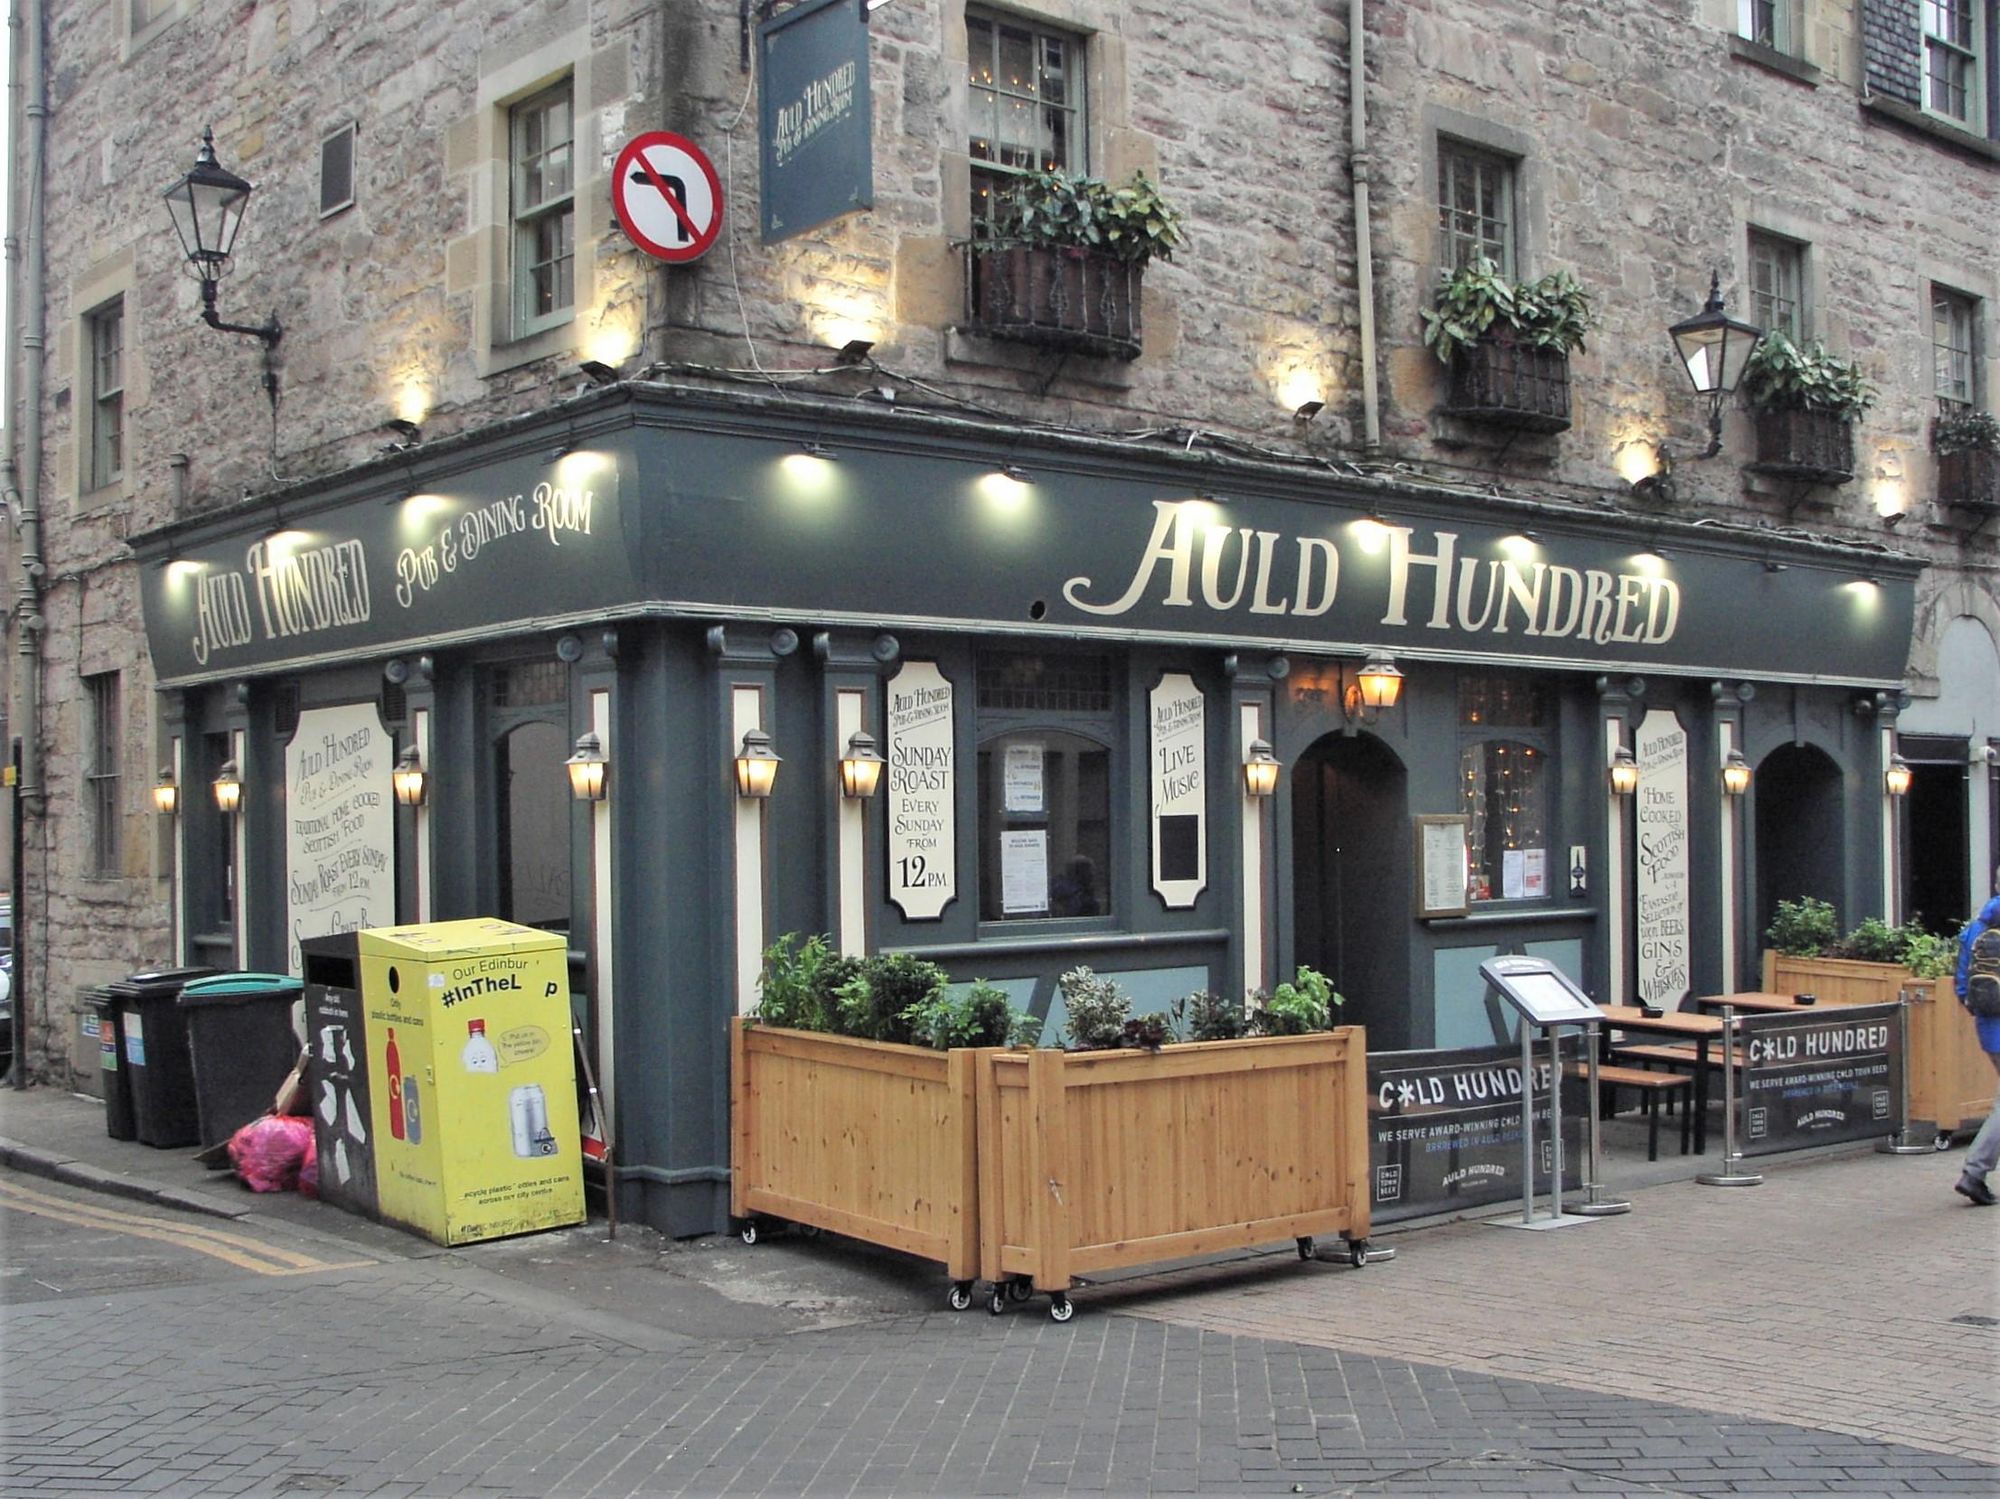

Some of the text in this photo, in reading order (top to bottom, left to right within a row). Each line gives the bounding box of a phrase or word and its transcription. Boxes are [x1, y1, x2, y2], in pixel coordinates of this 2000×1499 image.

[772, 61, 856, 147] AULD HUNDRED
[396, 482, 594, 608] PUB & DINING ROOM
[1062, 499, 1681, 646] AULD HUNDRED
[193, 538, 371, 665] AULD HUNDRED
[889, 687, 951, 717] AULD HUNDRED
[1154, 696, 1203, 729] AULD HUNDRED
[294, 727, 370, 793] AULD HUNDRED
[891, 737, 952, 770] SUNDAY
[1159, 744, 1196, 774] LIVE
[890, 766, 950, 795] ROAST
[1154, 770, 1200, 819] MUSIC
[902, 798, 939, 816] EVERY
[1644, 787, 1675, 805] HOME
[894, 813, 944, 836] SUNDAY
[1640, 806, 1682, 824] COOKED
[906, 838, 937, 851] FROM
[1640, 829, 1685, 866] SCOTTISH
[1647, 845, 1679, 884] FOOD
[1641, 940, 1683, 960] GINS
[453, 966, 476, 981] Our
[1655, 959, 1675, 978] &
[1806, 1025, 1888, 1057] HUNDRED
[1761, 1076, 1784, 1089] SERVE
[1378, 1130, 1393, 1143] WE
[1396, 1127, 1427, 1141] SERVE
[1428, 1118, 1499, 1138] AWARD-WINNING
[1797, 1112, 1814, 1128] AULD
[1814, 1109, 1846, 1121] HUNDRED
[1442, 1168, 1466, 1187] AULD
[1467, 1164, 1505, 1177] HUNDRED
